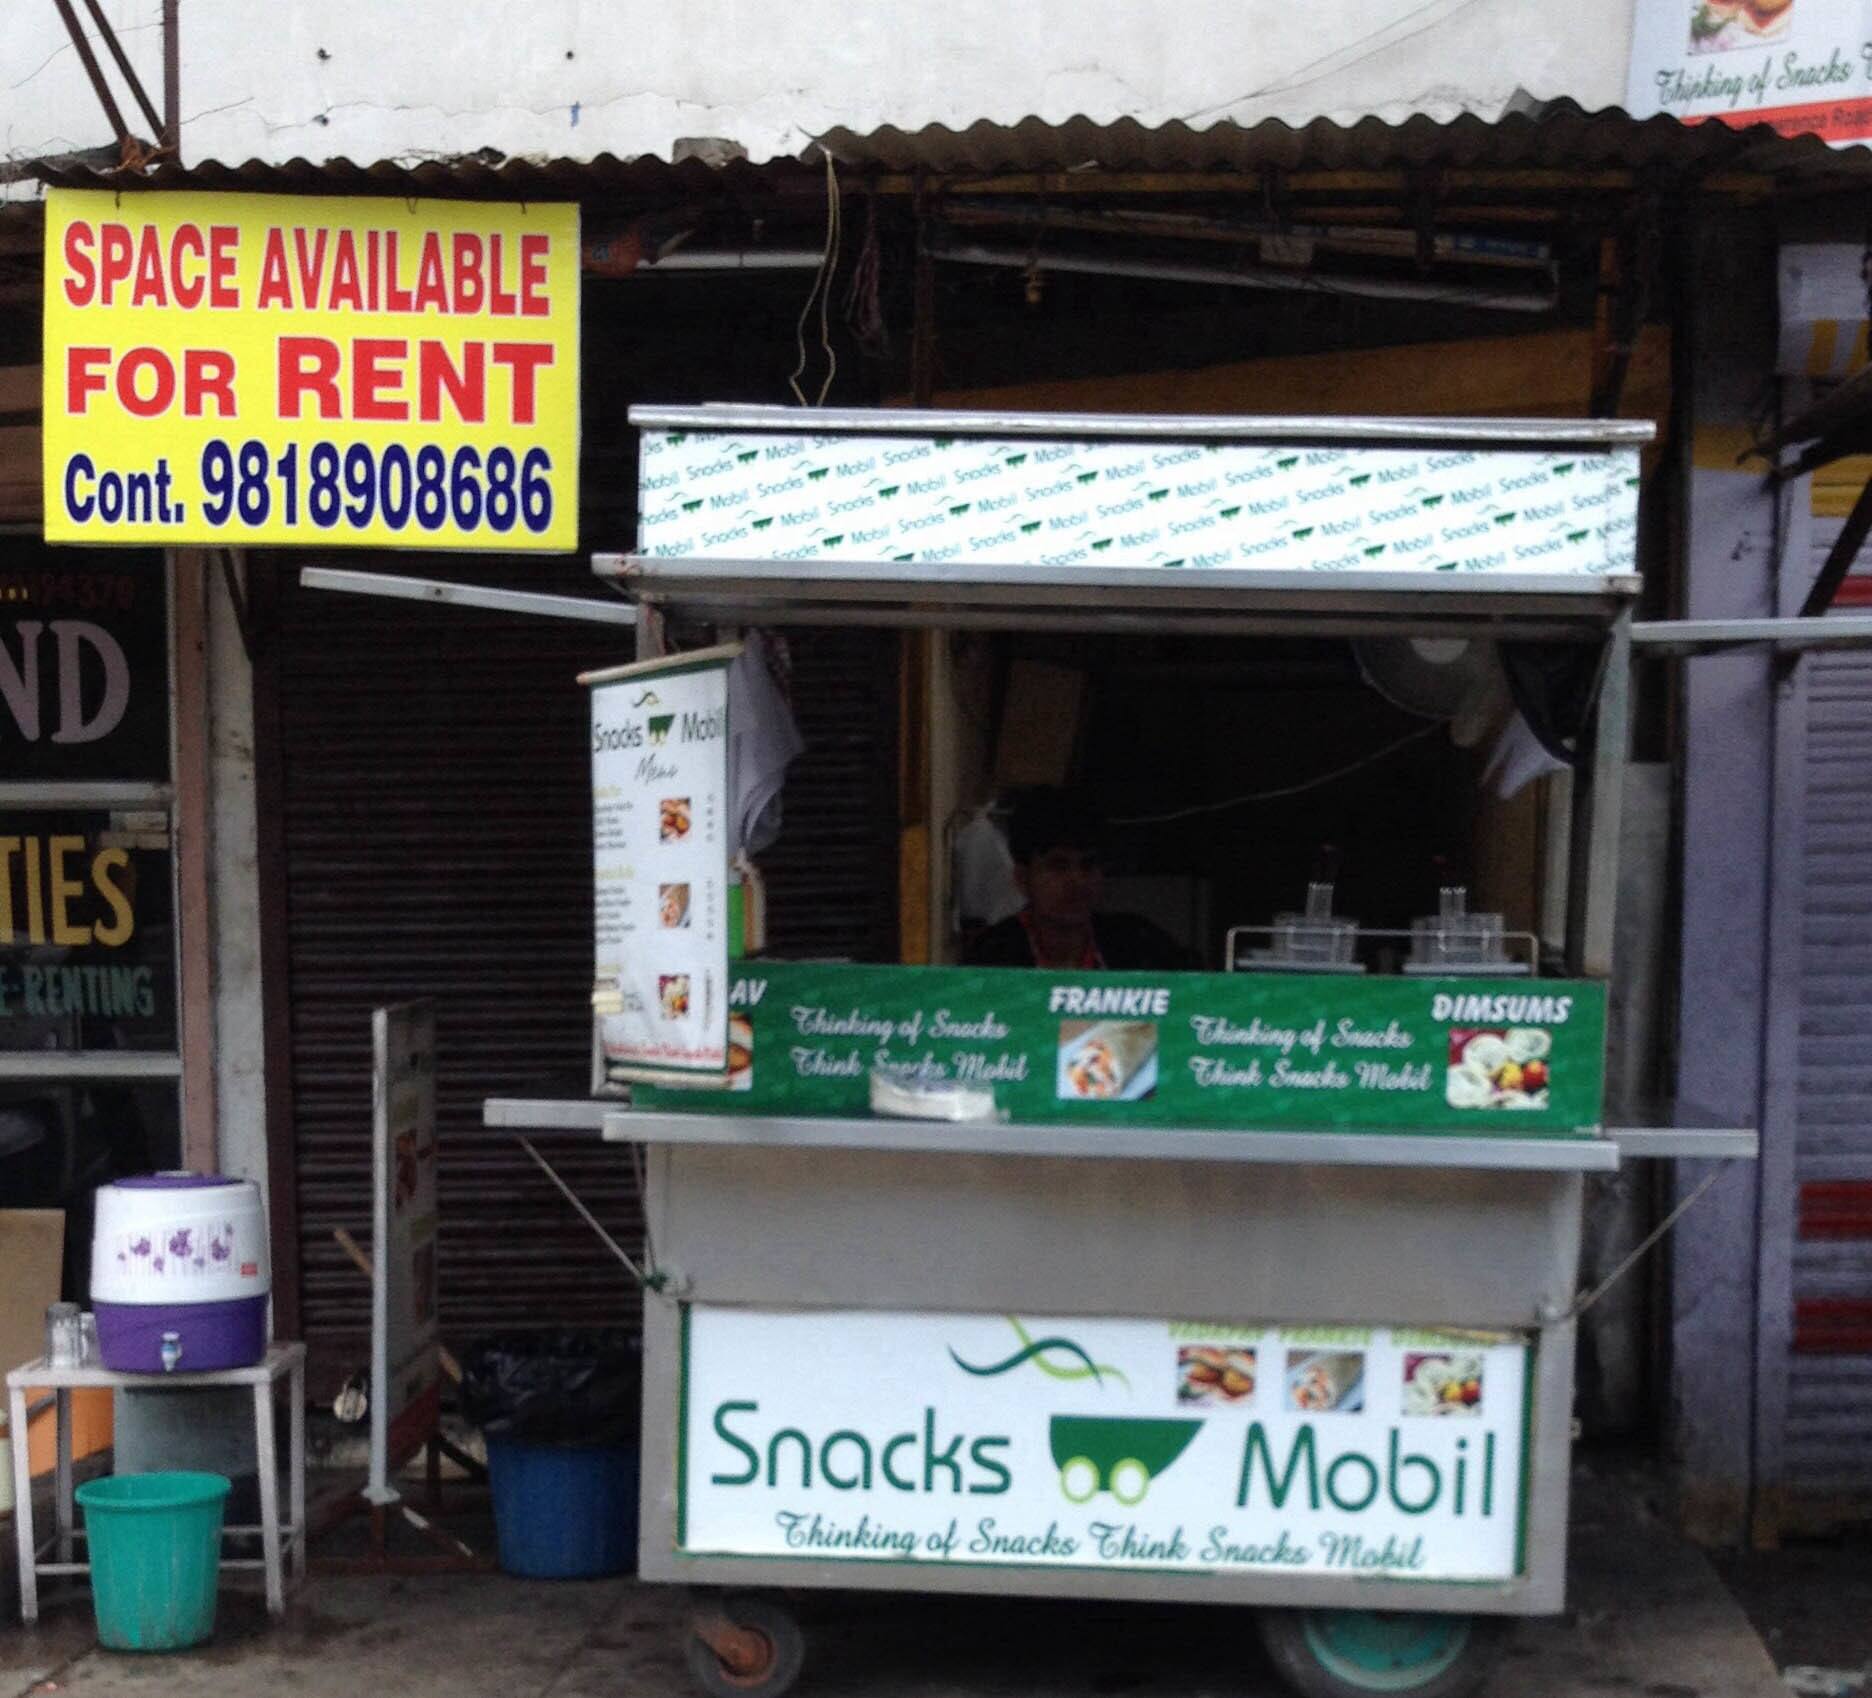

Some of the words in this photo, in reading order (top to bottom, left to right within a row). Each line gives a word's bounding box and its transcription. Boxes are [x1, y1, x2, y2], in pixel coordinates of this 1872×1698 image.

[1655, 64, 1742, 107] Thinking
[1749, 56, 1771, 104] of
[1777, 48, 1853, 89] Snacks
[64, 221, 240, 309] SPACE
[258, 227, 550, 317] AVAILABLE
[67, 346, 237, 417] FOR
[277, 336, 554, 425] RENT
[65, 454, 184, 523] Cont.
[202, 440, 552, 532] 9818908686
[790, 1006, 892, 1044] Thinking
[899, 1010, 922, 1046] of
[928, 1008, 1009, 1039] Snacks
[1049, 986, 1171, 1016] FRANKIE
[1432, 993, 1574, 1024] DIMSUMS
[1190, 1014, 1295, 1054] Thinking
[1300, 1020, 1326, 1055] of
[1330, 1018, 1415, 1049] Snacks
[790, 1046, 863, 1078] Think
[954, 1052, 1029, 1082] Mobil
[1188, 1056, 1264, 1088] Think
[1268, 1057, 1350, 1090] Snacks
[1355, 1061, 1433, 1091] Mobil
[711, 1400, 1012, 1496] Snacks
[1236, 1421, 1495, 1519] Mobil
[776, 1510, 917, 1561] Thinking
[926, 1513, 960, 1561] of
[968, 1513, 1081, 1558] Snacks
[1087, 1523, 1189, 1564] Think
[1200, 1526, 1308, 1566] Snacks
[1318, 1532, 1425, 1572] Mobil
